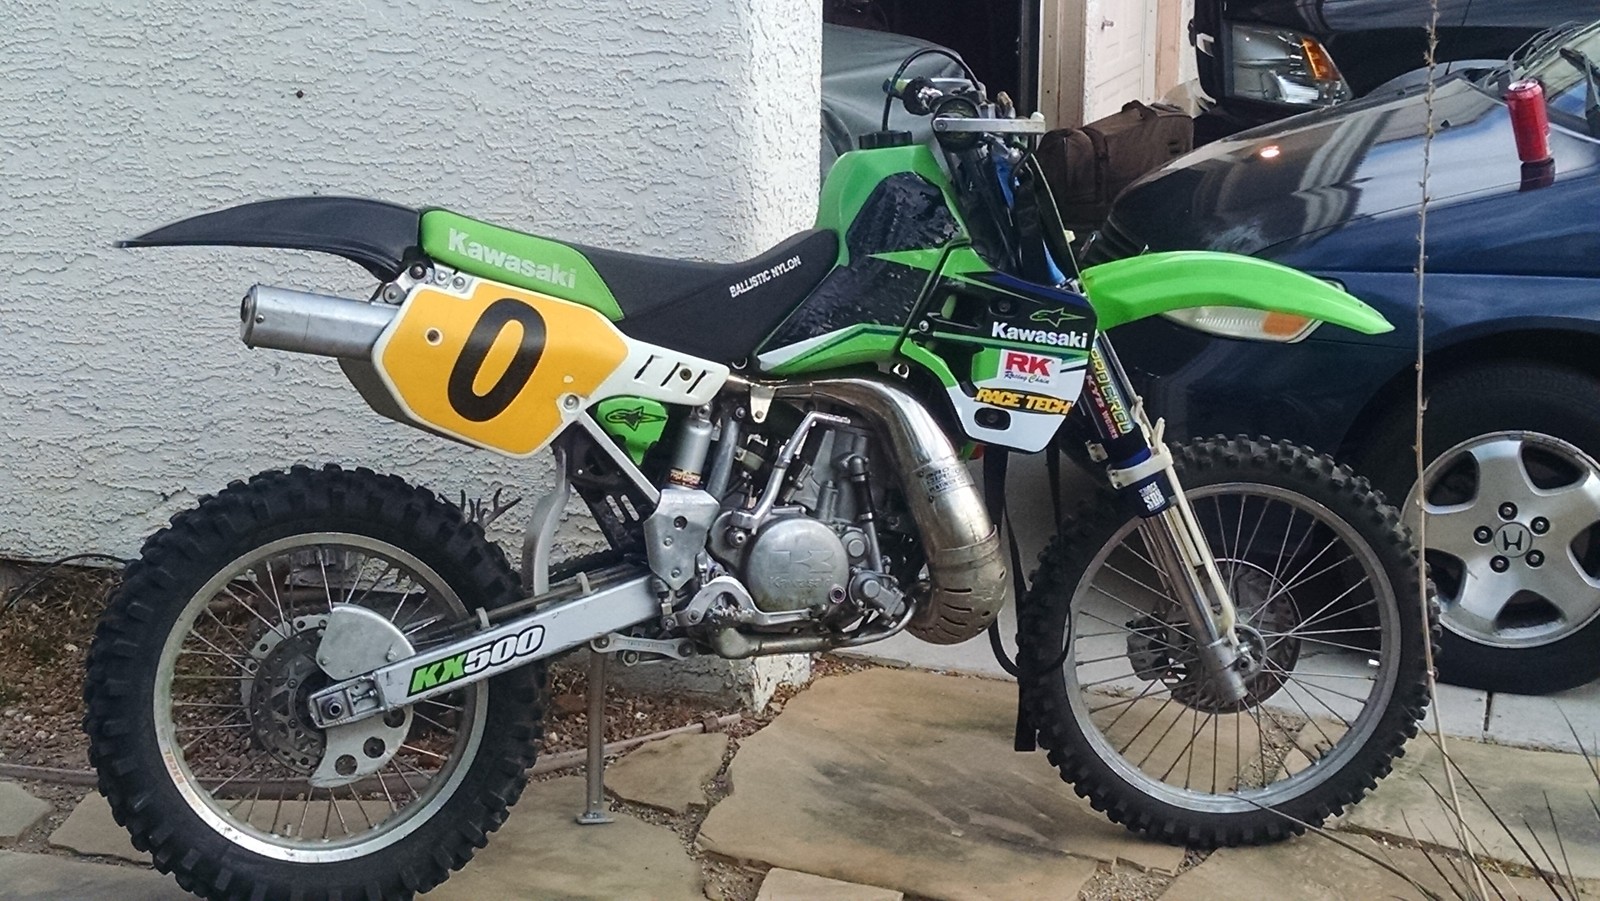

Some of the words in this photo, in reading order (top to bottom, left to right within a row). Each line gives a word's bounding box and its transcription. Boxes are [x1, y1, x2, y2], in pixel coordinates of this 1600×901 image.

[448, 227, 578, 290] Kawasaki
[729, 269, 772, 298] BALLISTIC
[770, 255, 802, 278] NYLON
[991, 321, 1089, 349] Kawasaki
[447, 297, 548, 423] 0
[1005, 352, 1053, 377] RK
[975, 388, 1026, 408] RACE
[1025, 394, 1074, 415] TECH
[1101, 384, 1135, 434] CIRCU
[406, 625, 546, 698] KX500
